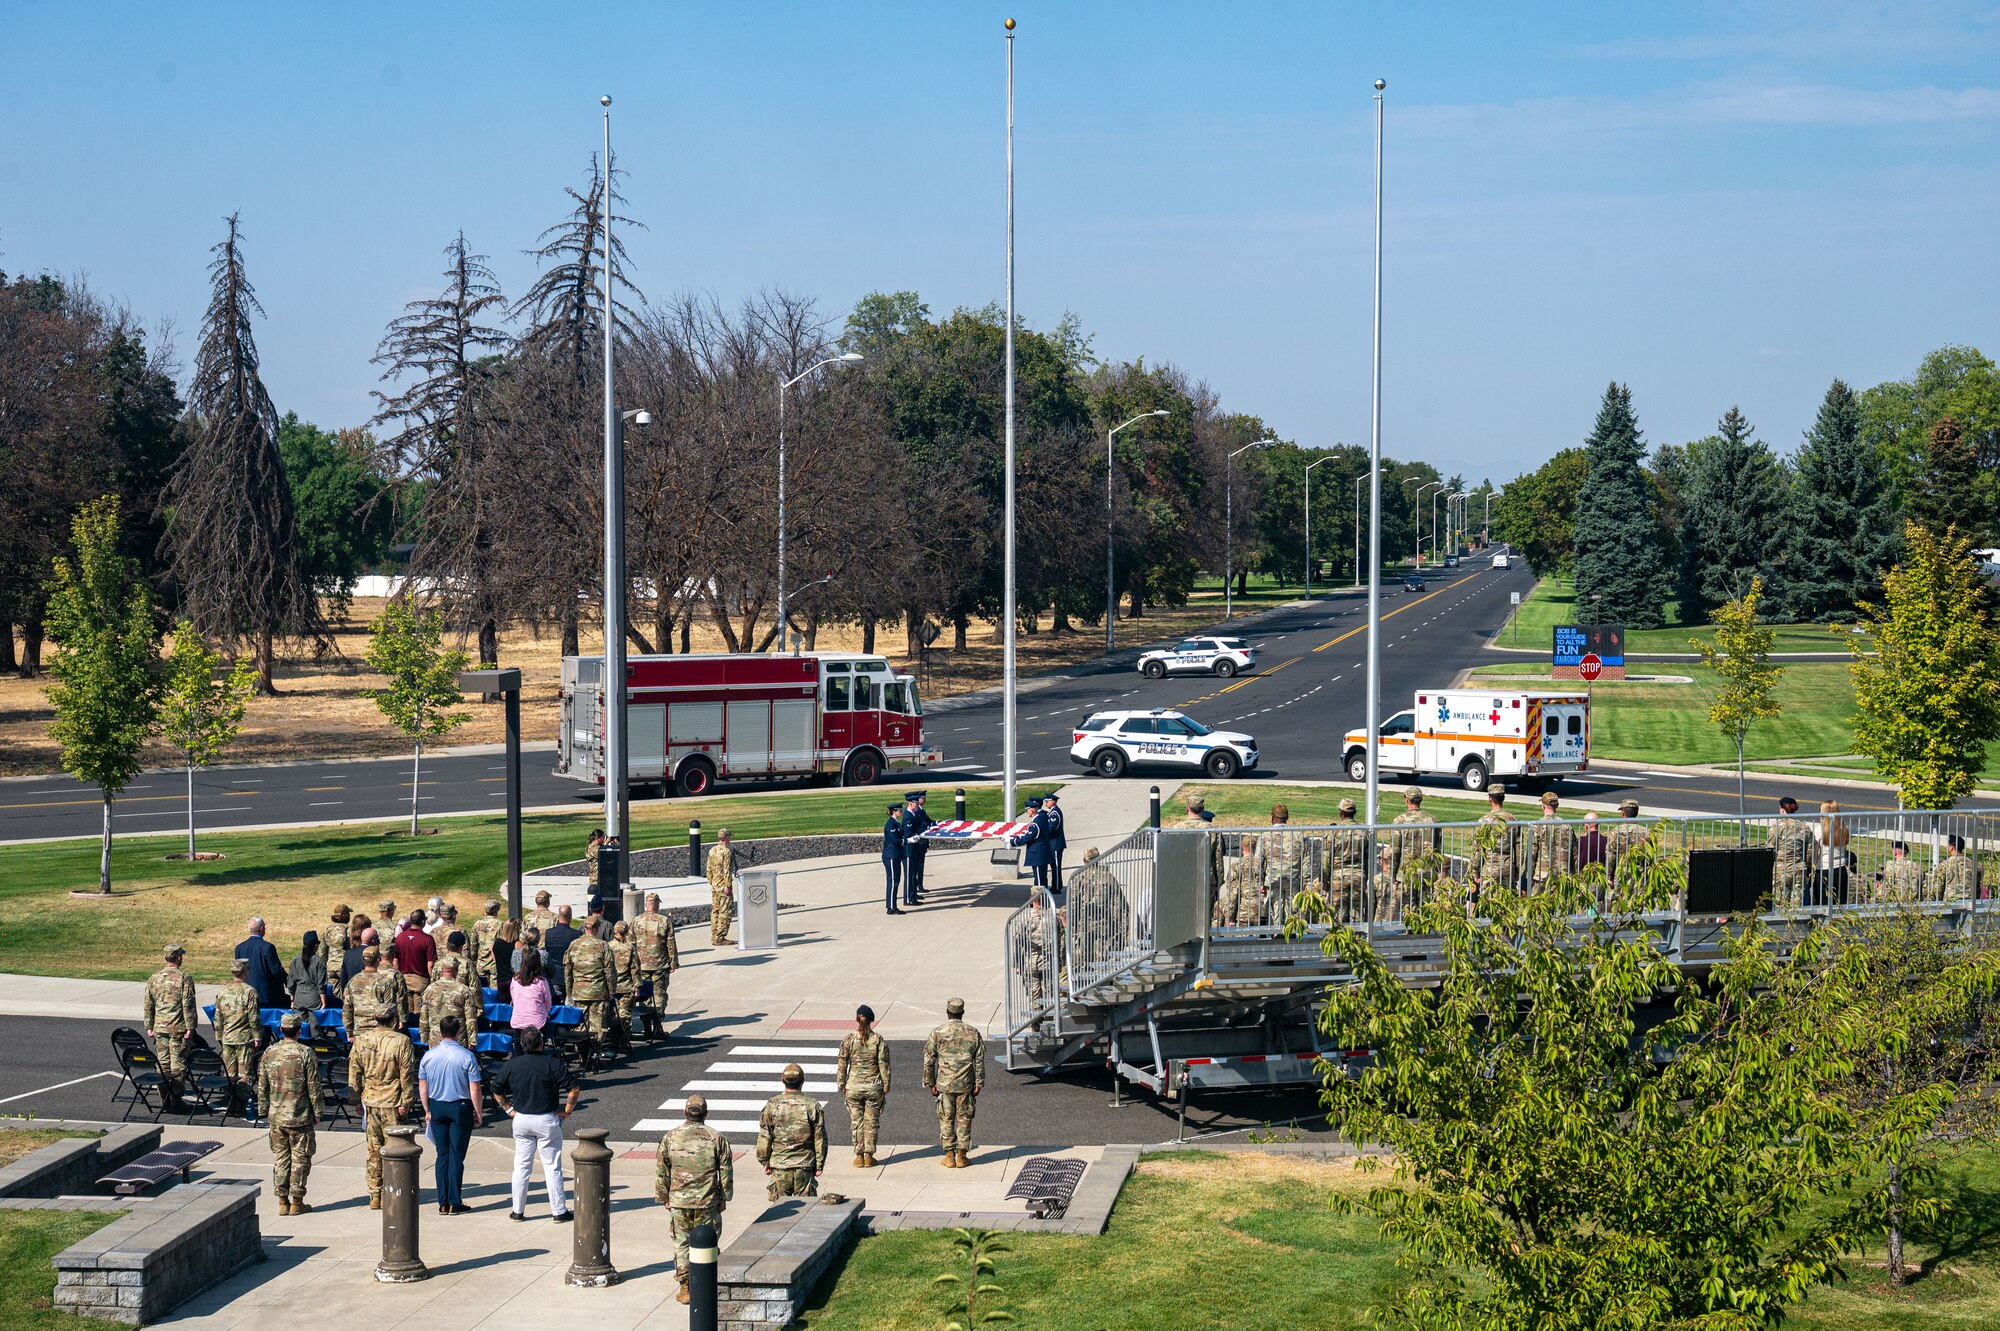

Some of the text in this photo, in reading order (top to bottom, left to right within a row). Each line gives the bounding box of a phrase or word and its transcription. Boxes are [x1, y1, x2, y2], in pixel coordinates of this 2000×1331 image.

[1556, 645, 1579, 655] FUN
[1182, 655, 1206, 664] POLICE
[1581, 663, 1601, 673] STOP
[1453, 711, 1486, 721] AMBULANCE
[1467, 722, 1472, 732] 1
[1137, 742, 1178, 755] POLICE
[1547, 750, 1579, 759] AMBULANCE
